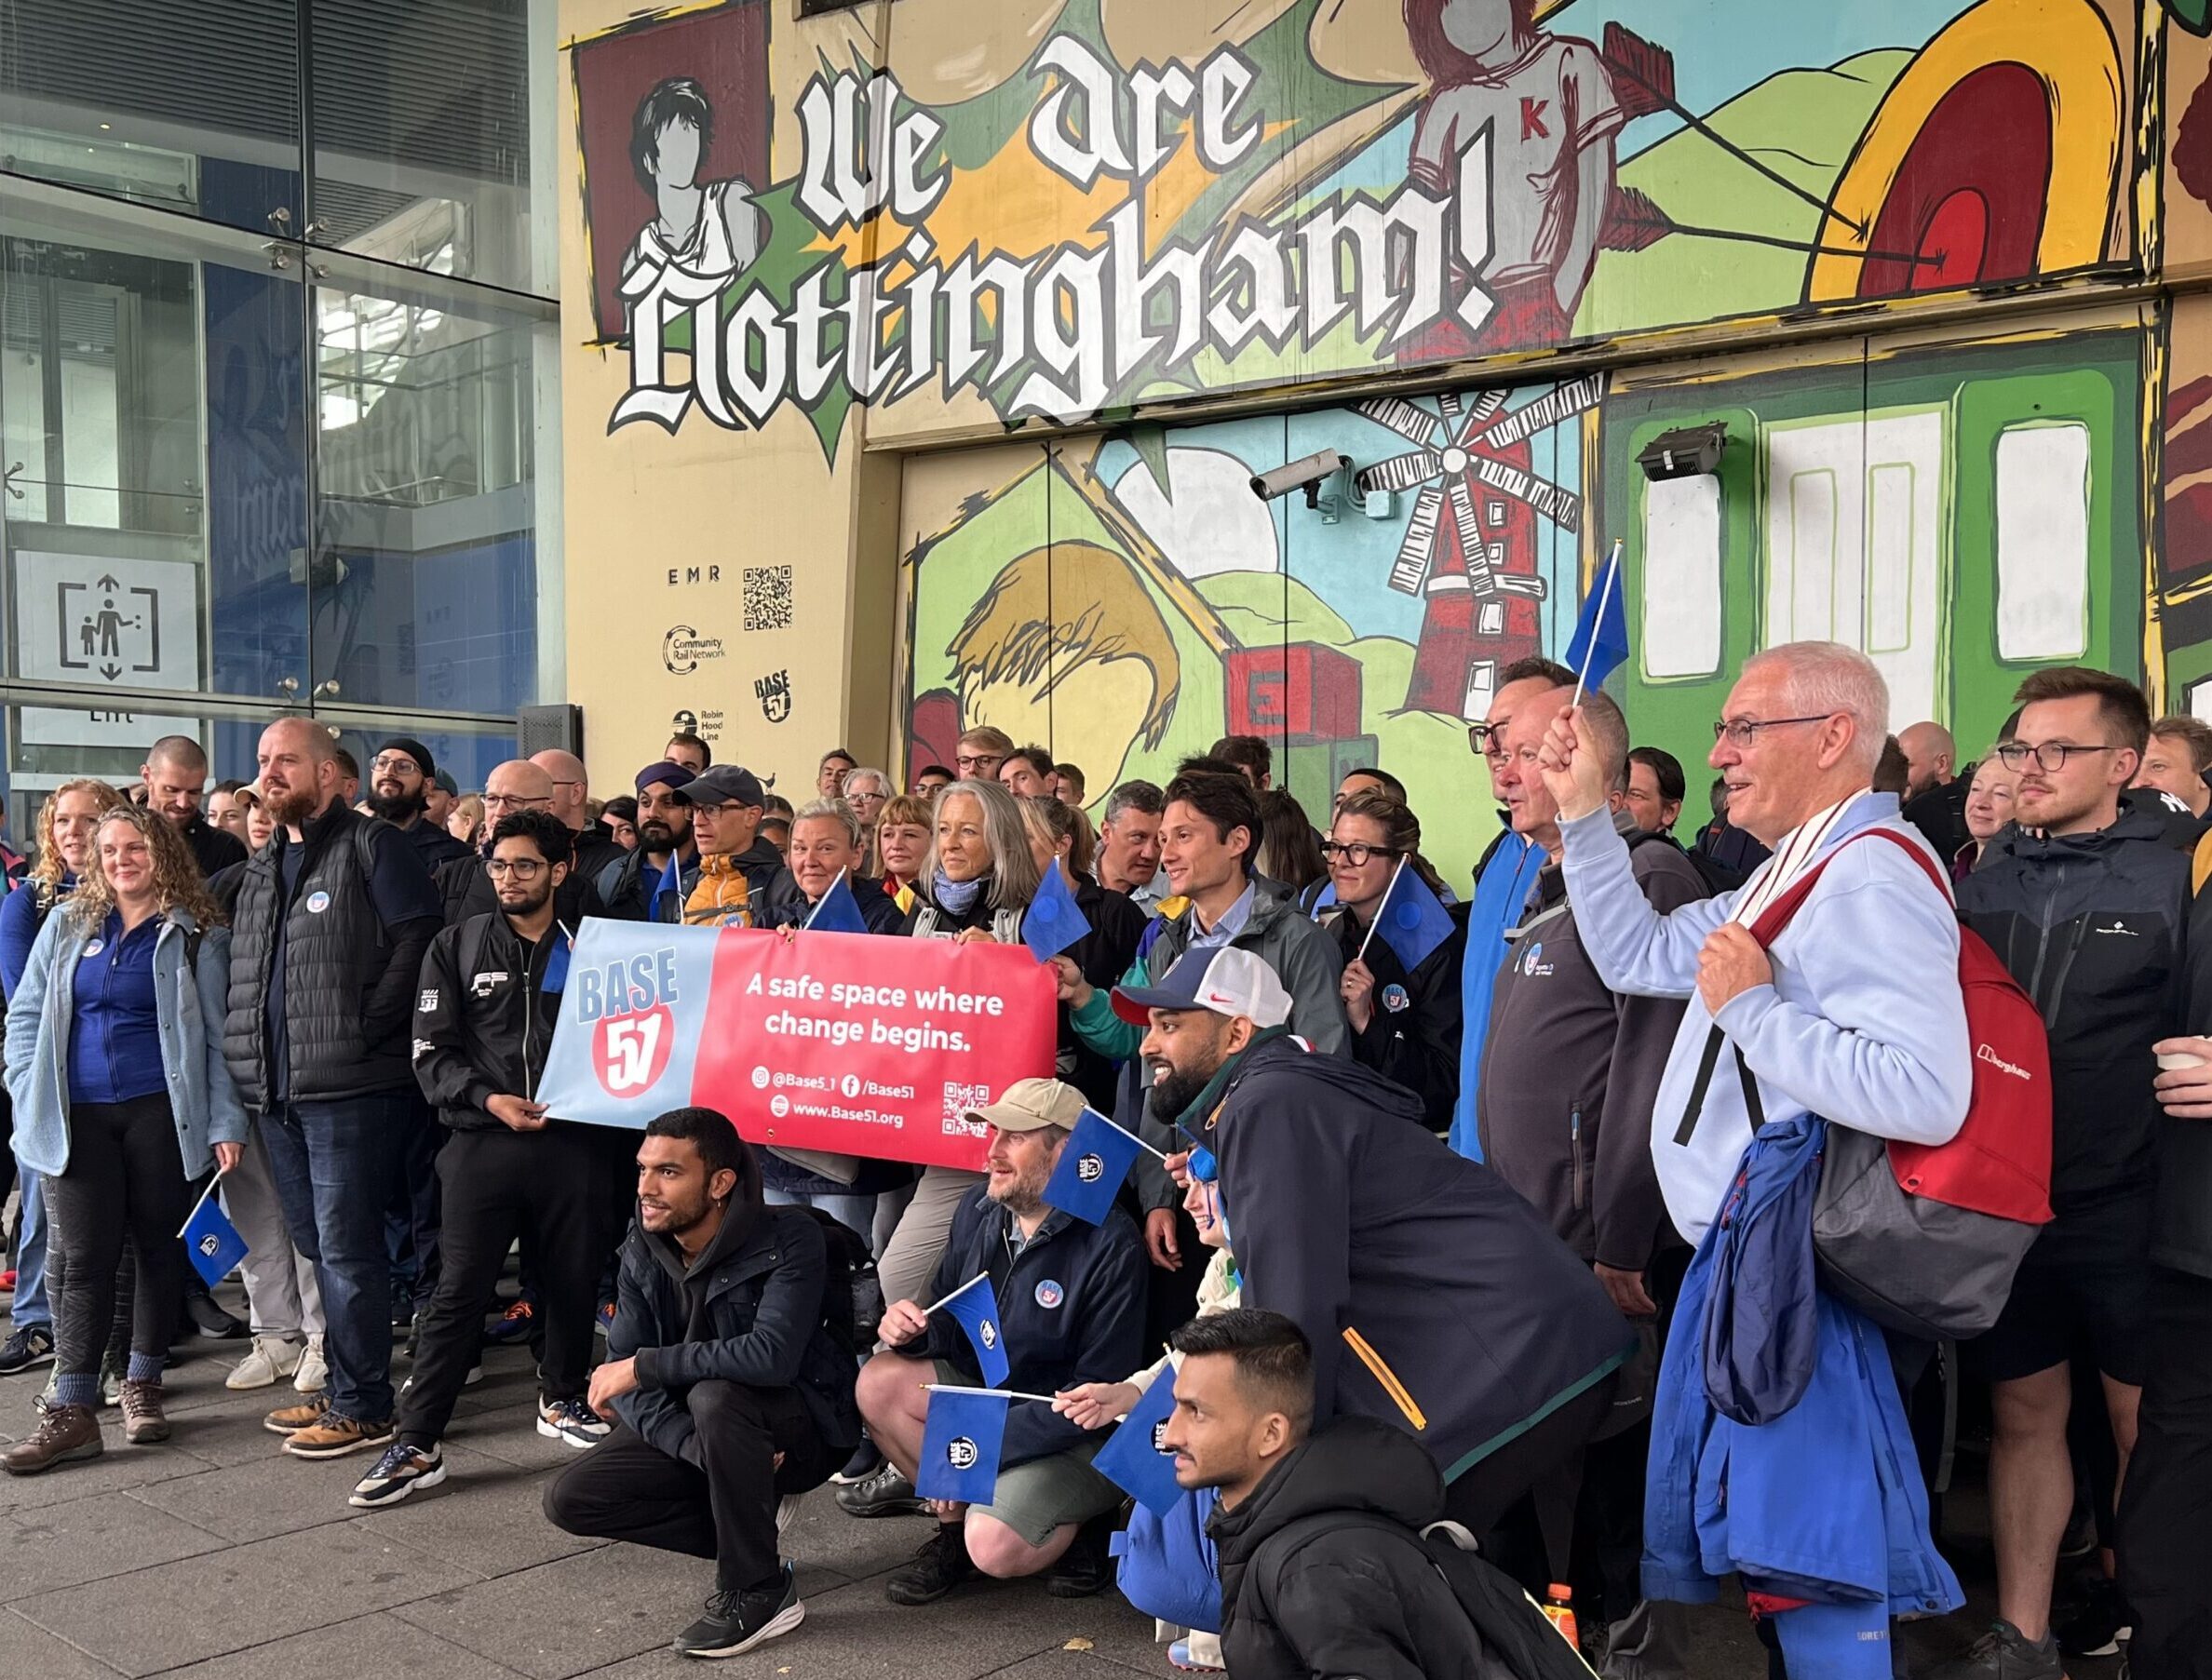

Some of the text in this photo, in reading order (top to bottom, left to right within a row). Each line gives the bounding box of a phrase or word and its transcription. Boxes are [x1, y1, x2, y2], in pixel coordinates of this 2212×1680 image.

[1518, 96, 1550, 143] K
[798, 68, 949, 228] We
[609, 133, 1493, 433] Nottingham!
[673, 638, 722, 650] Community
[673, 648, 725, 660] Rail Network
[754, 668, 790, 699] BASE
[701, 710, 723, 719] Robin
[766, 692, 786, 720] 51
[701, 721, 722, 730] Hood
[701, 732, 719, 741] Line
[577, 946, 679, 1026] BASE
[746, 973, 1004, 1015] A safe space where
[764, 1010, 971, 1053] change begins.
[606, 1013, 663, 1090] 51
[773, 1072, 835, 1092] @Base5_1
[862, 1080, 914, 1099] /Base51
[793, 1103, 904, 1128] www.Base51.org
[951, 1442, 960, 1463] BASE
